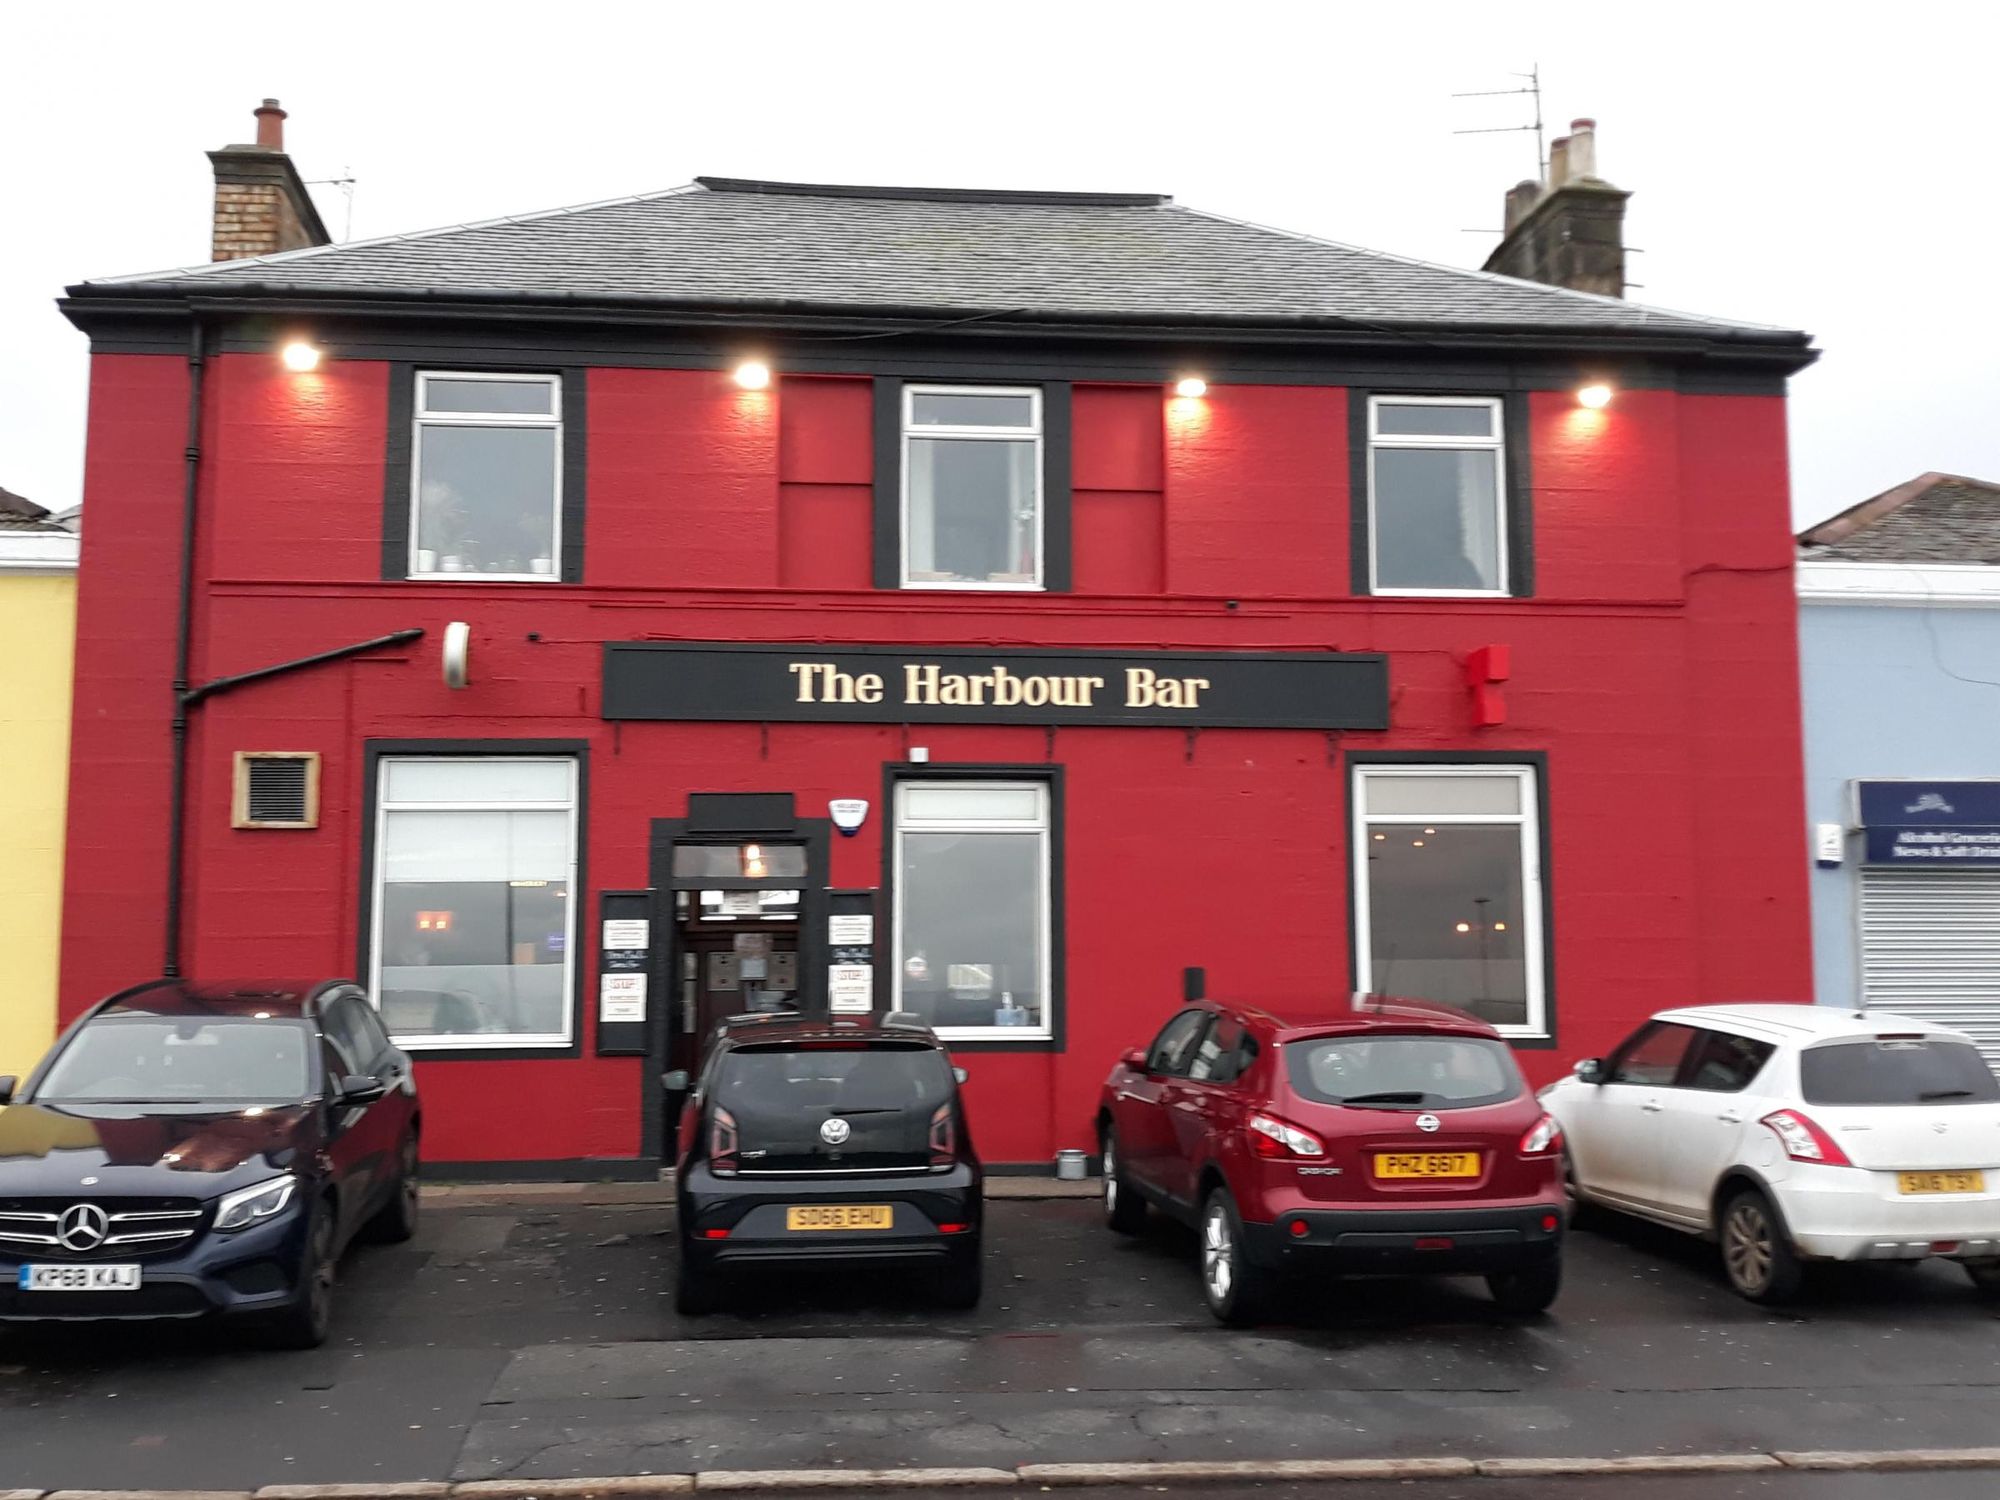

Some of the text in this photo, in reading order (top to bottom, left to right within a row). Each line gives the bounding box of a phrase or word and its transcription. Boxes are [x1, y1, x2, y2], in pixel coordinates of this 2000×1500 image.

[789, 663, 1210, 708] The Harbour Bar
[1386, 1154, 1466, 1174] PHZ 6617
